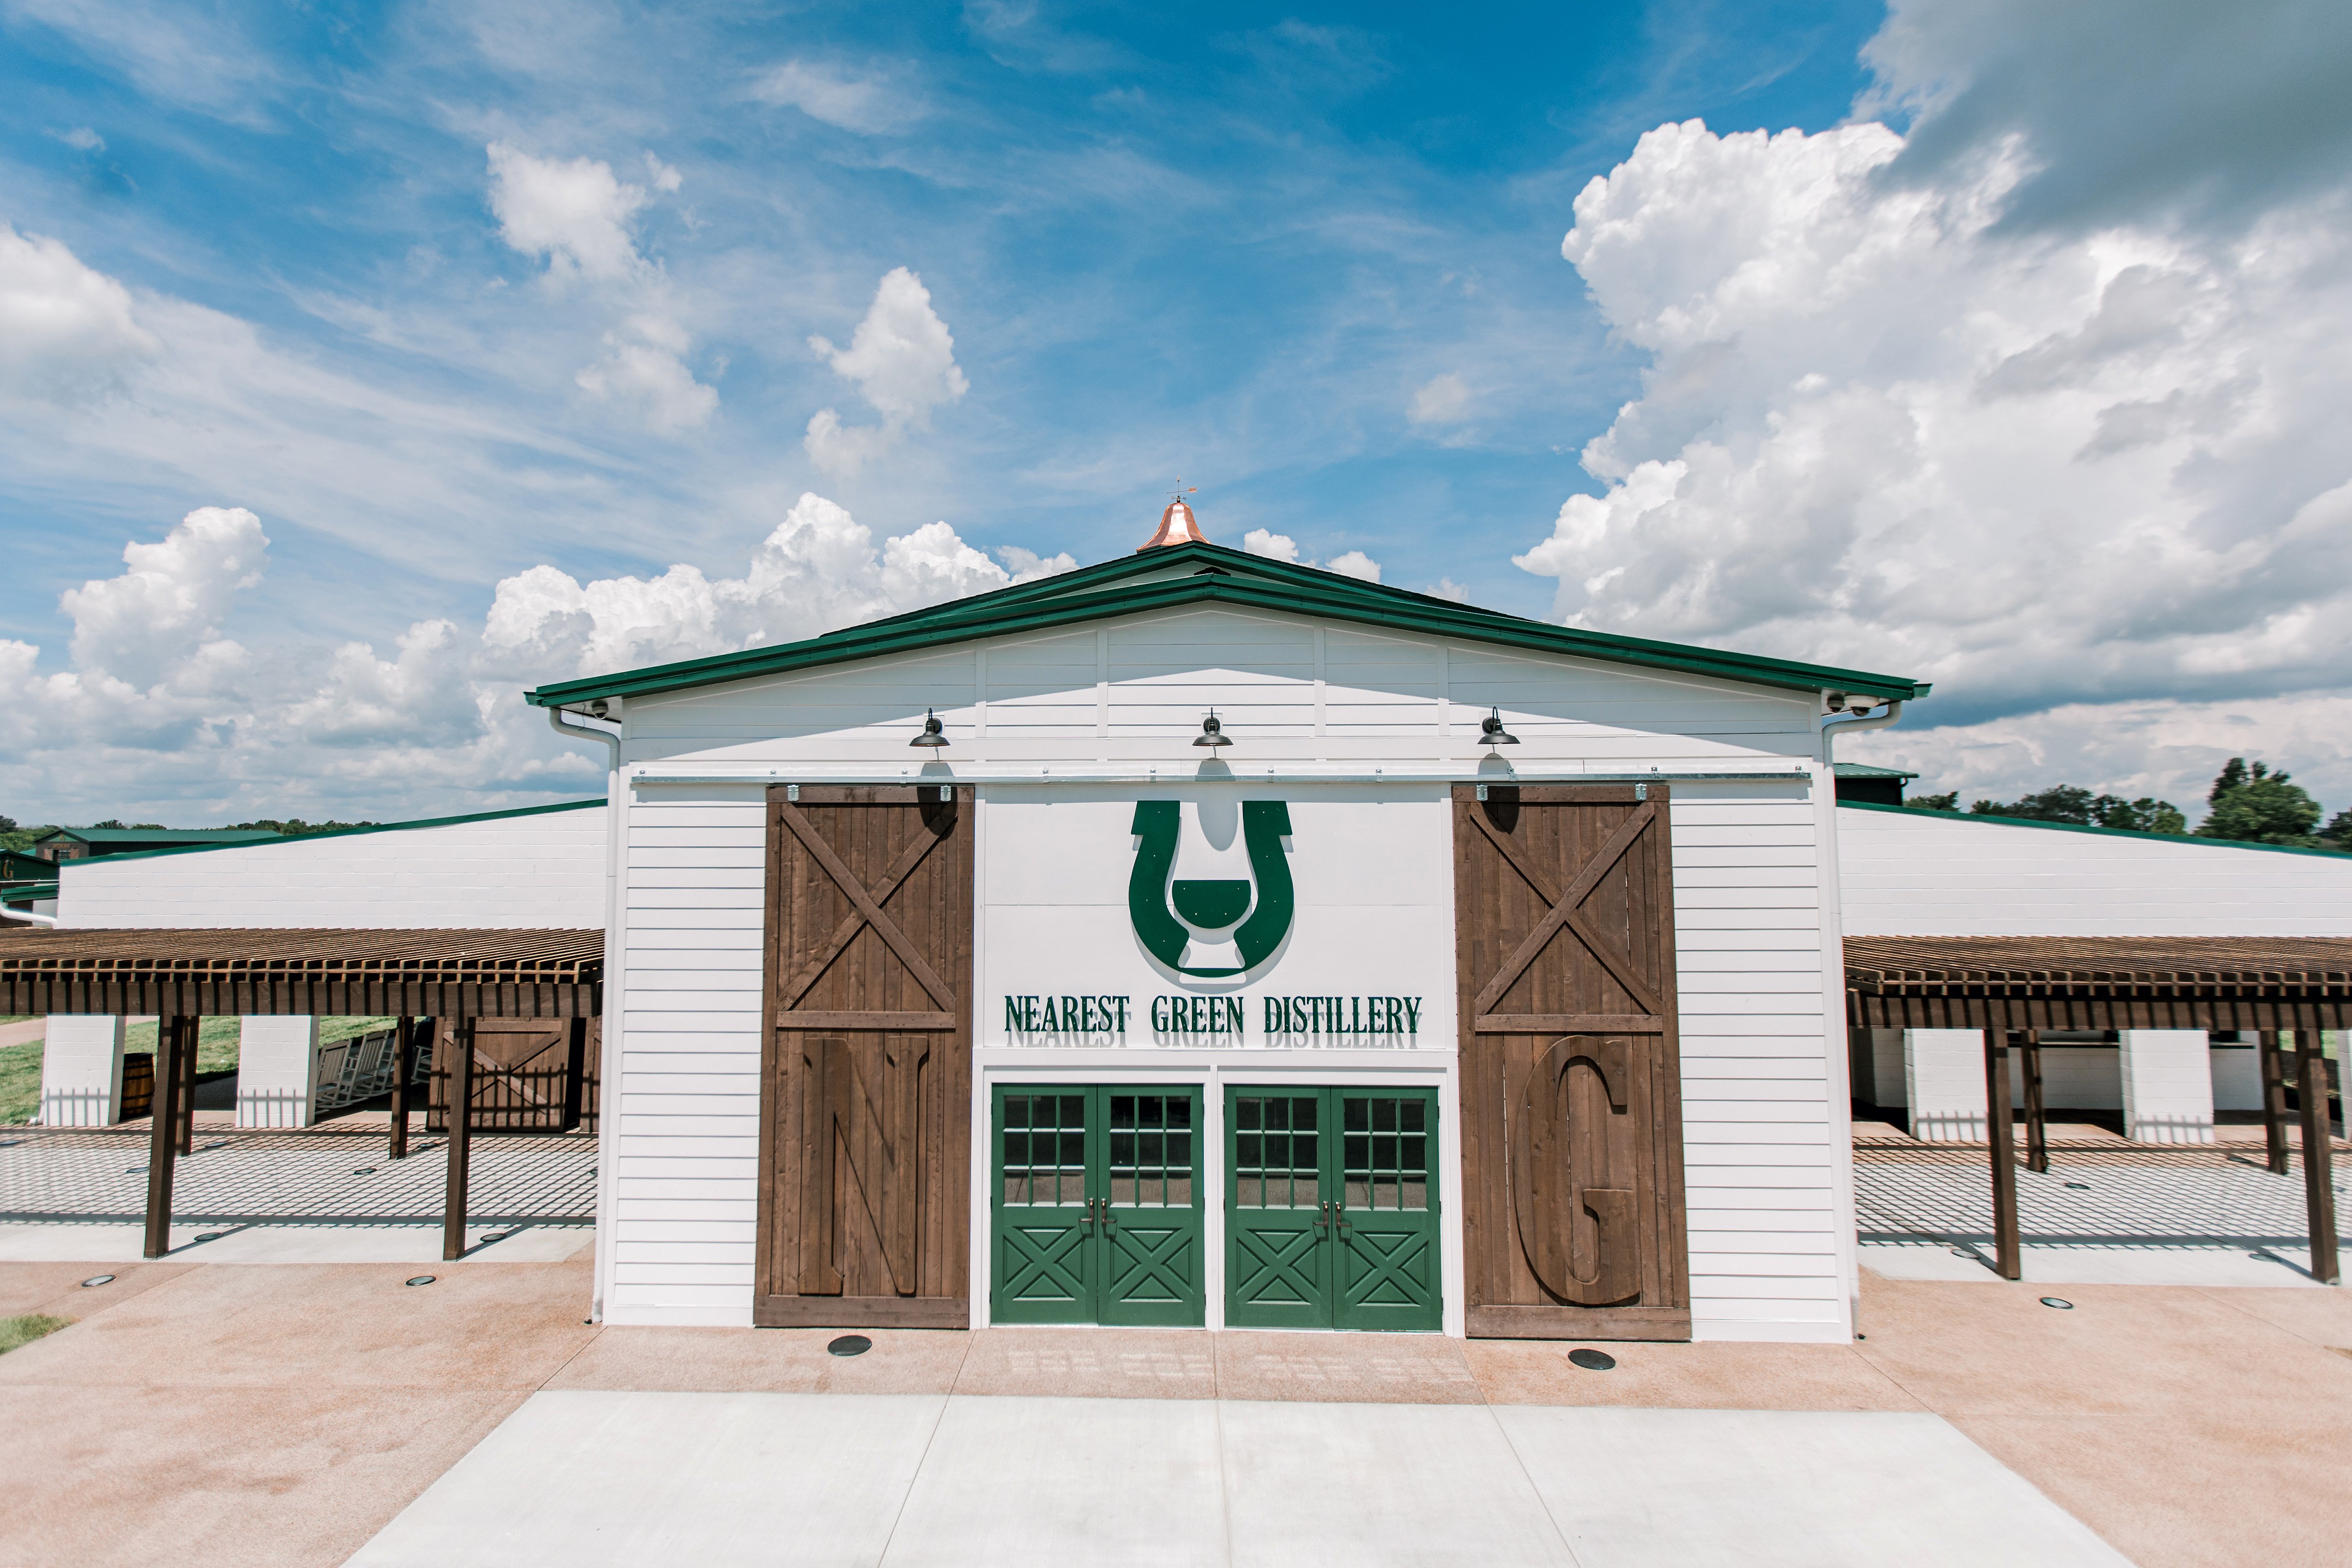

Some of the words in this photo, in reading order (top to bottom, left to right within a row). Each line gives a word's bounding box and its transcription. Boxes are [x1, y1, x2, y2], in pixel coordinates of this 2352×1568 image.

[1005, 995, 1130, 1032] NEAREST
[1151, 995, 1244, 1033] GREEN
[1264, 996, 1422, 1034] DISTILLERY
[798, 1036, 929, 1295] N
[1513, 1035, 1641, 1305] G
